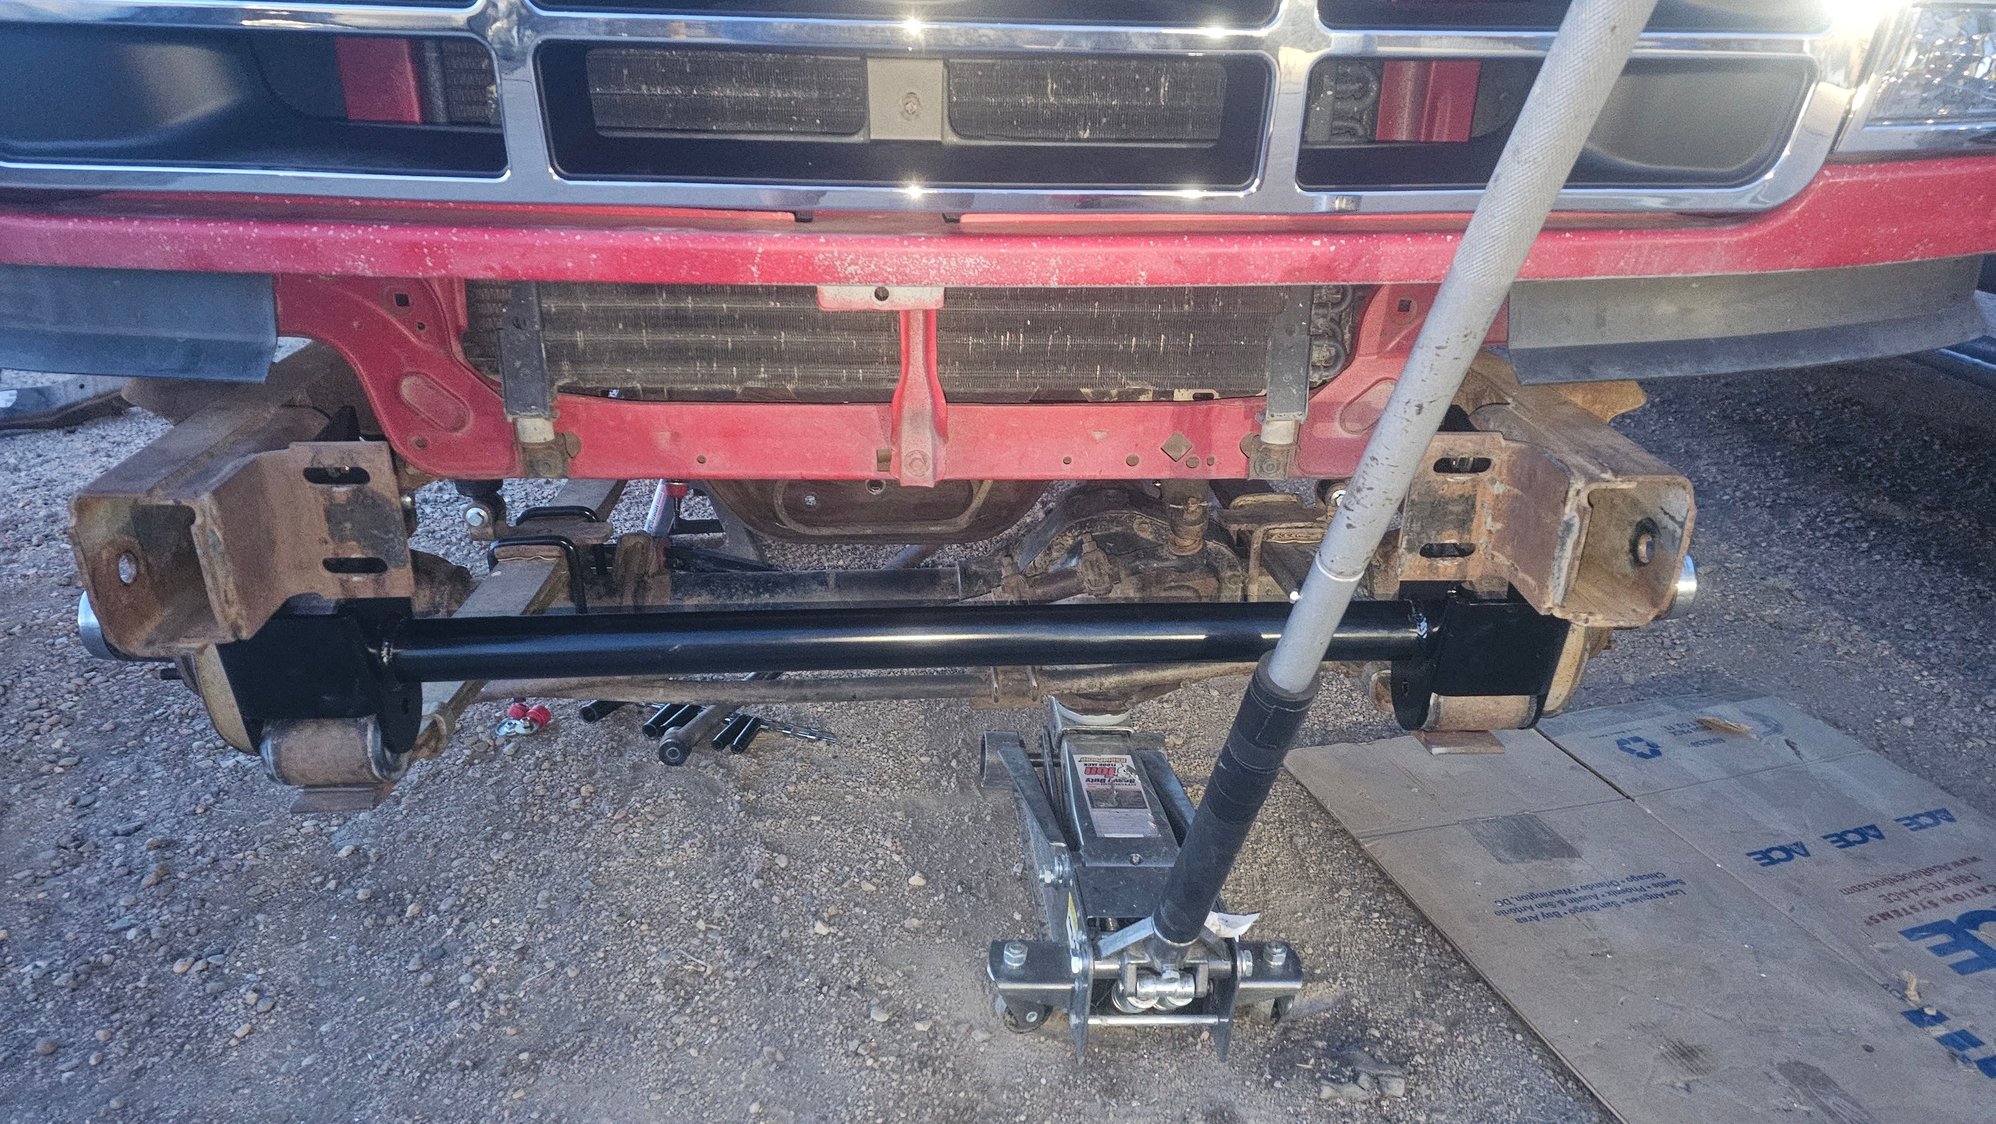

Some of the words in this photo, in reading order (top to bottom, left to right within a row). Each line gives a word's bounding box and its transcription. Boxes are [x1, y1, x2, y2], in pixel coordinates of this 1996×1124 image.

[1894, 808, 1956, 832] ACE
[1821, 824, 1885, 849] ACE
[1746, 841, 1810, 867] ACE
[1626, 871, 1667, 882] Chicago
[1580, 879, 1620, 891] Orlando
[1651, 878, 1686, 889] Seattle
[1607, 886, 1647, 897] Phoenix
[1664, 888, 1687, 896] Los
[1566, 893, 1599, 904] Austin
[1625, 892, 1665, 904] Angeles
[1568, 904, 1600, 914] Diego
[1600, 900, 1621, 909] San
[1494, 904, 1535, 917] Antonio
[1542, 910, 1563, 920] Bay
[1515, 915, 1540, 924] Area
